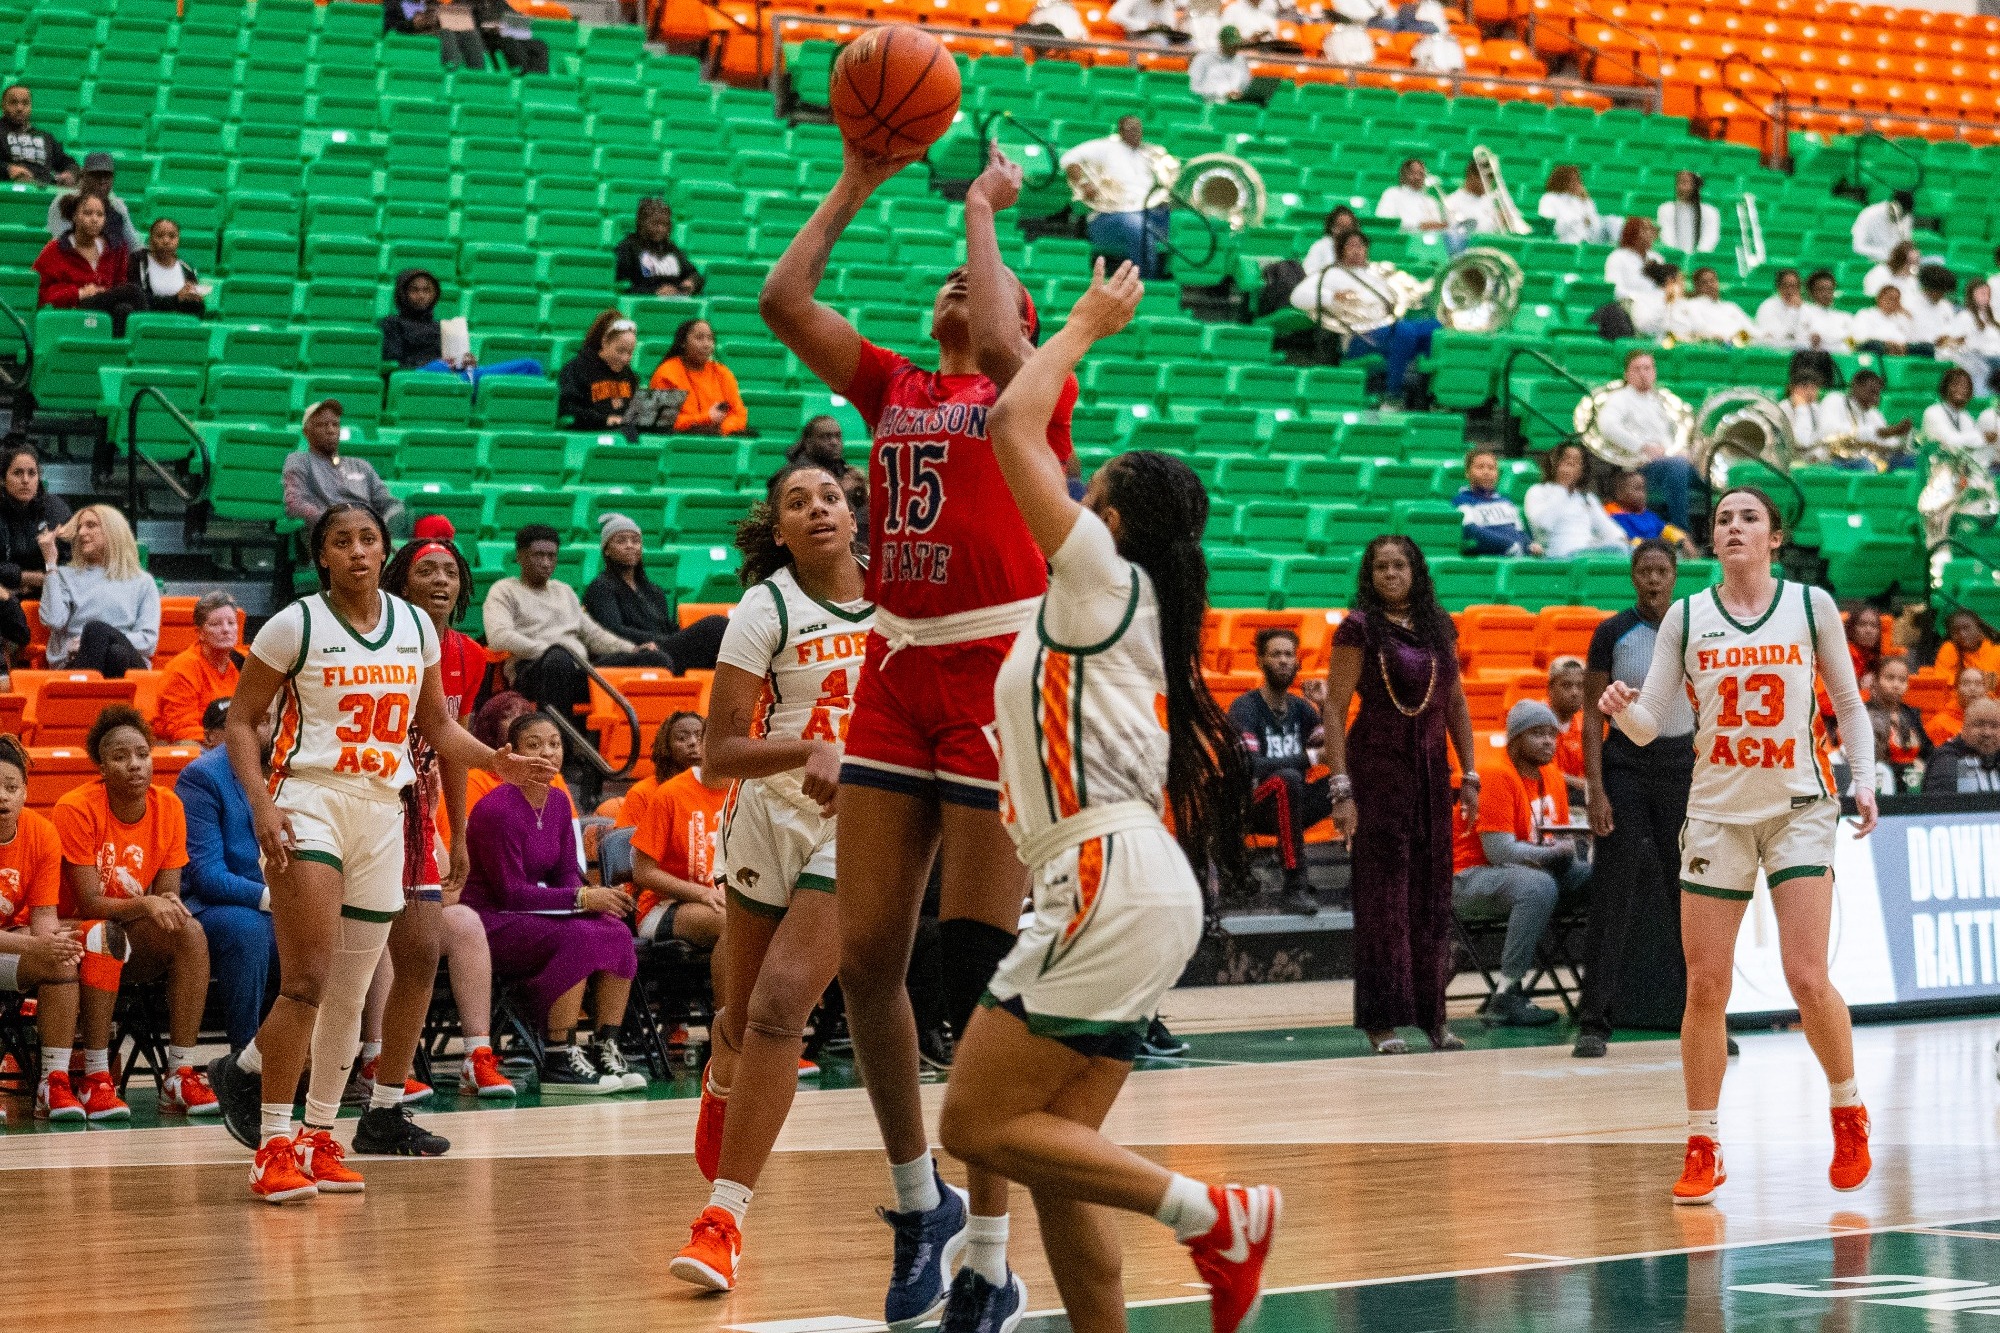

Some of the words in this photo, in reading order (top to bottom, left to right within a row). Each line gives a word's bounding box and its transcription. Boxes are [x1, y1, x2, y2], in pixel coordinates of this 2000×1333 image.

[879, 440, 949, 536] 15
[882, 541, 952, 585] TATE
[795, 632, 868, 666] FLOR
[1697, 644, 1802, 671] FLORIDA
[322, 664, 417, 687] FLORIDA
[335, 692, 410, 744] 30
[1717, 673, 1785, 728] 13
